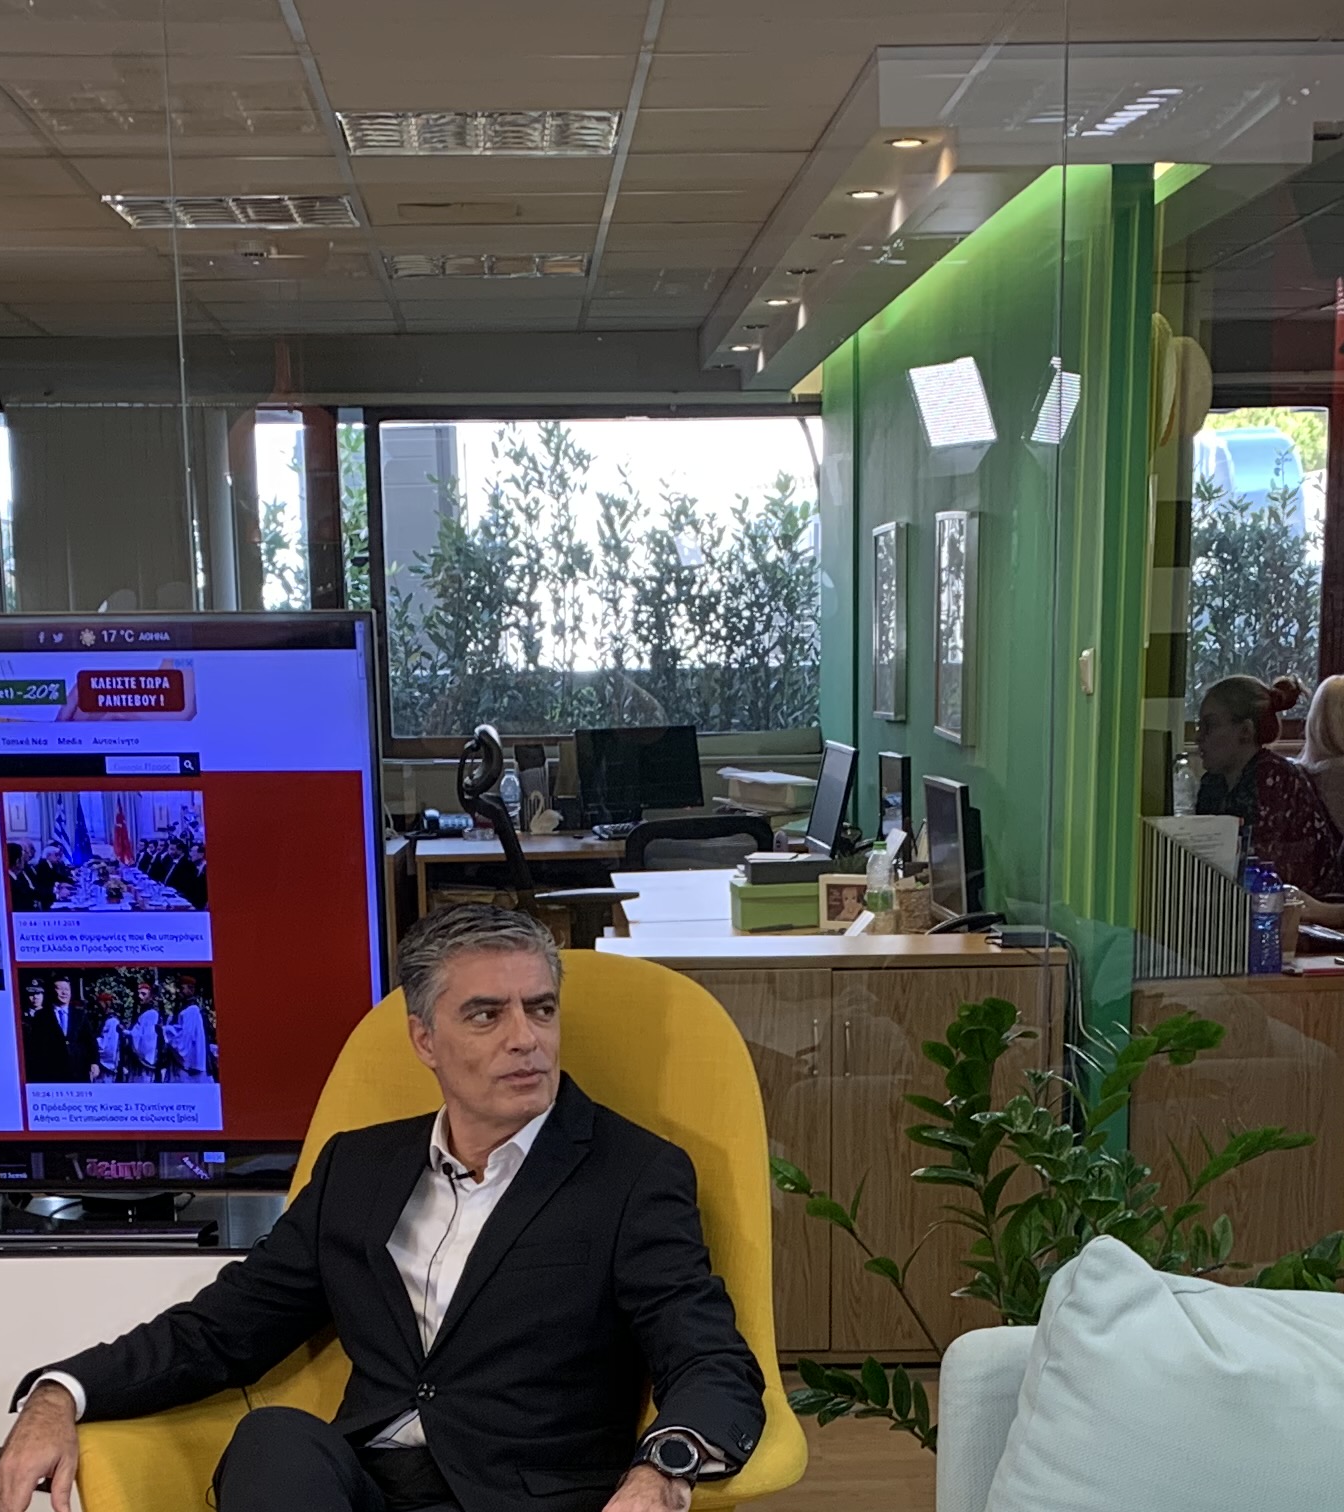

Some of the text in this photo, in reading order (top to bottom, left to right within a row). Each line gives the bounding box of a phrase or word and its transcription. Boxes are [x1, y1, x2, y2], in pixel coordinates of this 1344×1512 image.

[101, 630, 116, 642] 17
[90, 676, 170, 689] ΚΛΕΙΣΤΕ ΤΩΡΑ
[98, 694, 158, 707] ΡΑΝΤΕΒΟΥ
